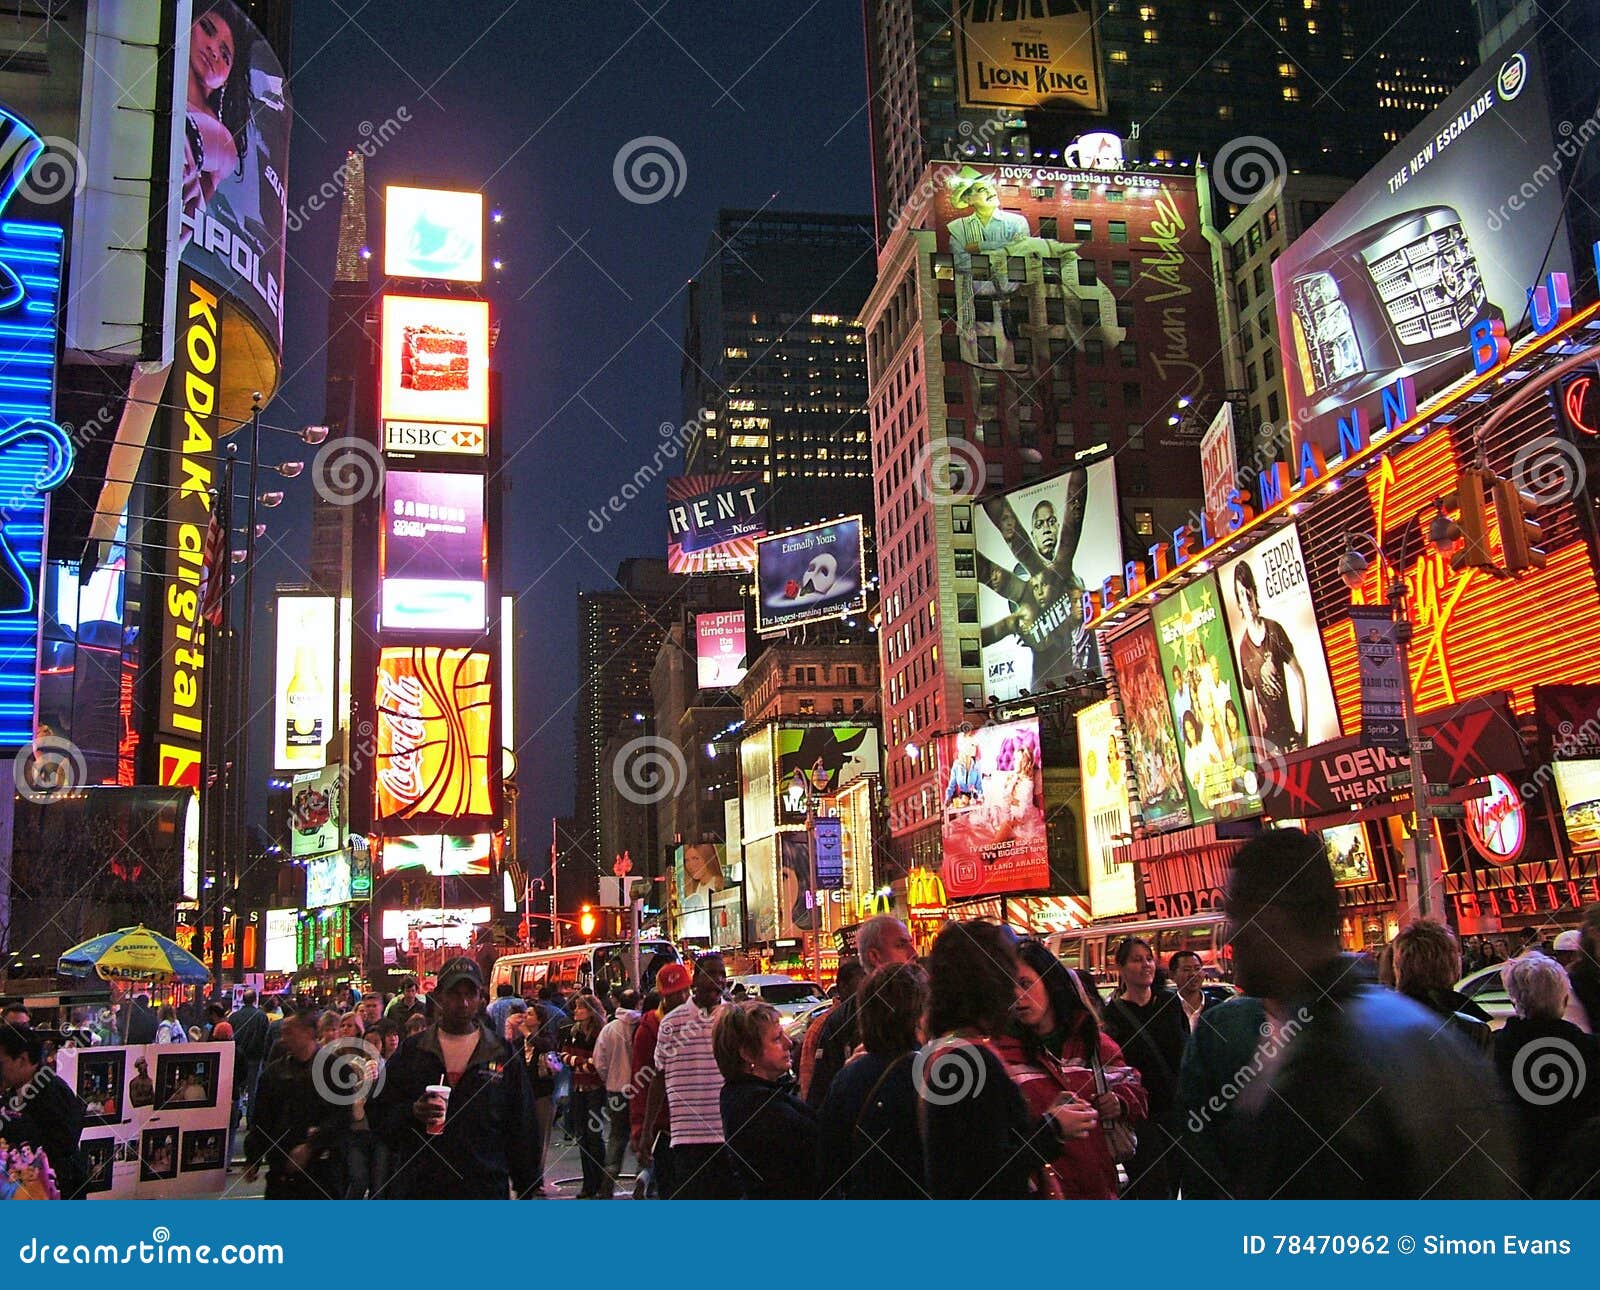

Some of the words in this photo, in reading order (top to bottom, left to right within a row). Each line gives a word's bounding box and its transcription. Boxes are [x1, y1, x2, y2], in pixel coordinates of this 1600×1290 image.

[1012, 41, 1049, 59] THE
[978, 62, 1029, 89] LION
[1035, 65, 1088, 93] KING
[1388, 166, 1408, 195] THE
[1410, 144, 1434, 178] NEW
[1435, 89, 1495, 153] ESCALADE
[1000, 166, 1033, 180] 100%
[1036, 169, 1111, 185] Colombian
[1114, 176, 1161, 188] Coffee
[1140, 183, 1192, 302] Valdez
[1150, 307, 1204, 395] Juan
[181, 279, 217, 512] KODAK
[387, 427, 448, 447] HSBC
[668, 487, 756, 534] RENT
[1083, 376, 1416, 625] BERTELSMANN
[782, 537, 814, 554] Eternally
[816, 534, 837, 546] Yours
[1261, 536, 1297, 574] TEDDY
[1264, 563, 1305, 600] GEIGER
[716, 611, 745, 627] prim
[762, 616, 773, 627] The
[822, 602, 847, 613] musical
[1029, 596, 1072, 644] THIEF
[700, 627, 724, 637] time
[379, 666, 427, 804] Coca-Cola
[1367, 725, 1390, 737] Sprint
[983, 840, 1015, 852] BIGGEST
[997, 847, 1029, 858] BIGGEST
[1015, 857, 1047, 868] AWARDS
